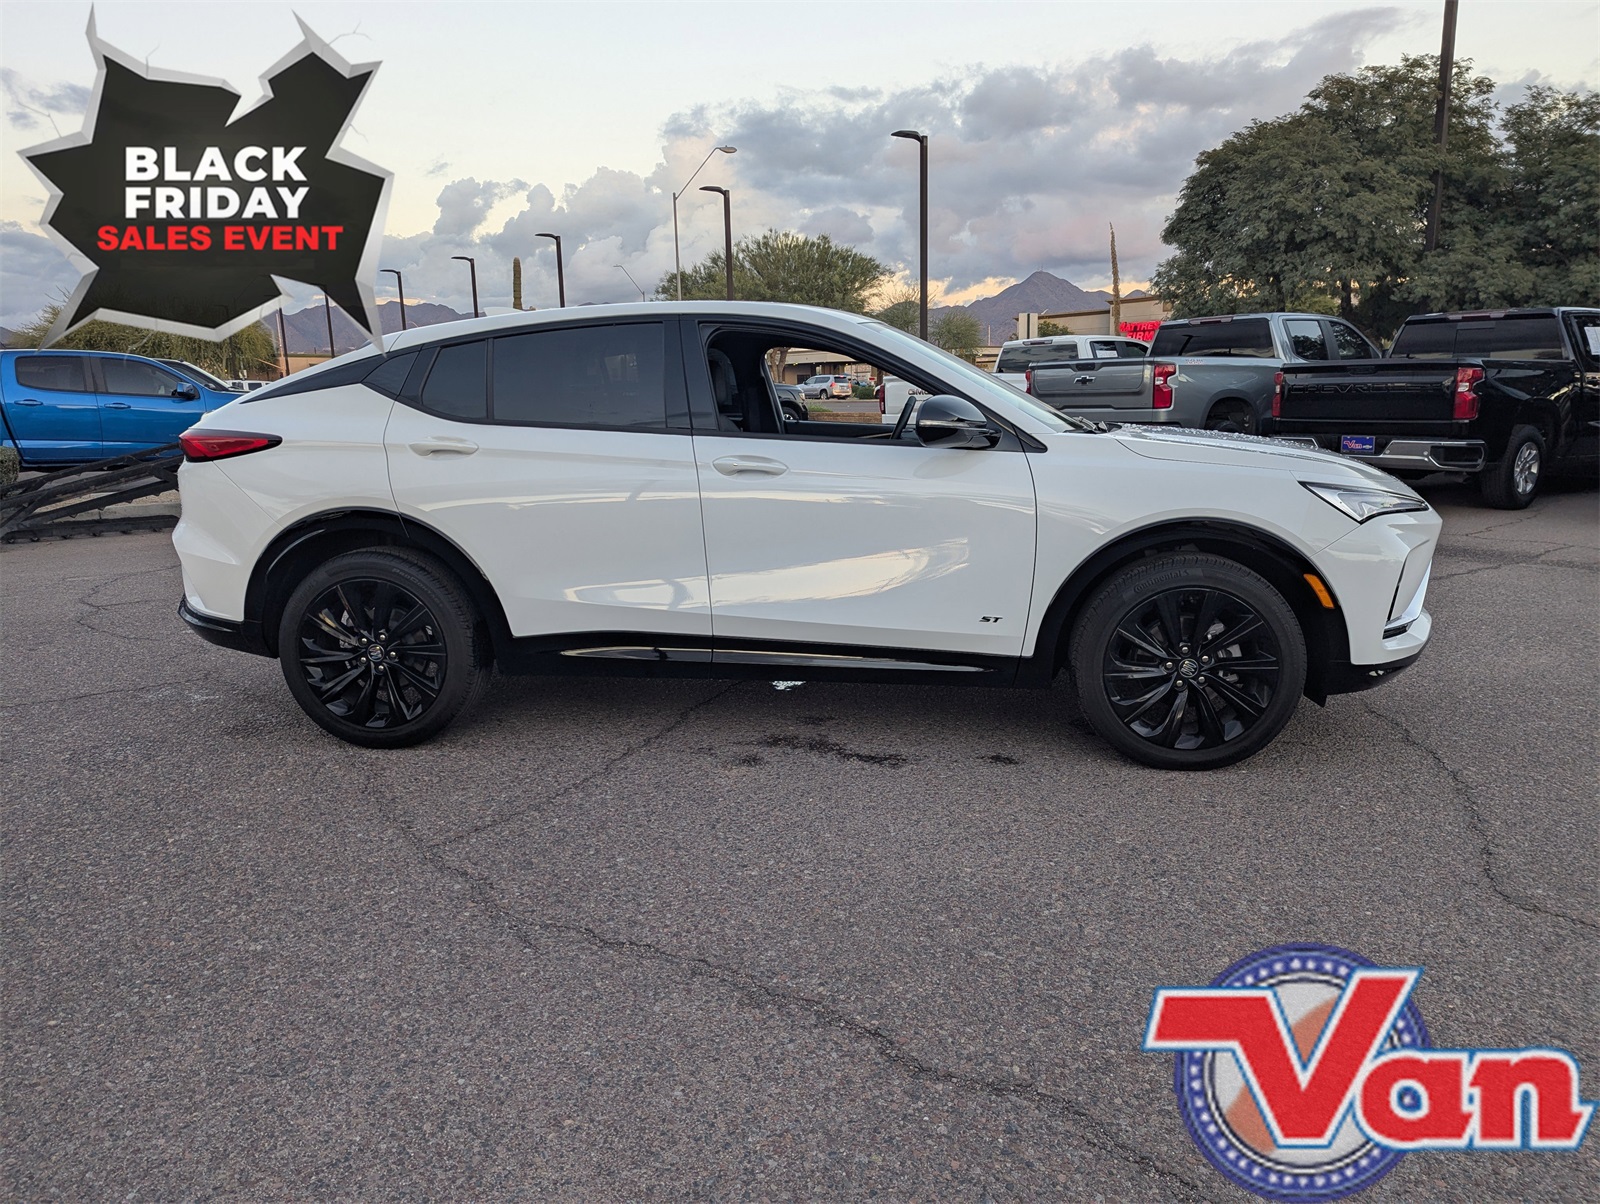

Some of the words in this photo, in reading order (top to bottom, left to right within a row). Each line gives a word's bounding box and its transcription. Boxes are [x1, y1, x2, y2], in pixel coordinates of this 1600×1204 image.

[1119, 320, 1160, 332] MATTRES
[1126, 330, 1155, 341] FIRM
[1290, 384, 1441, 393] CHEVROLET
[1344, 440, 1363, 449] Van
[1133, 570, 1182, 593] Continental
